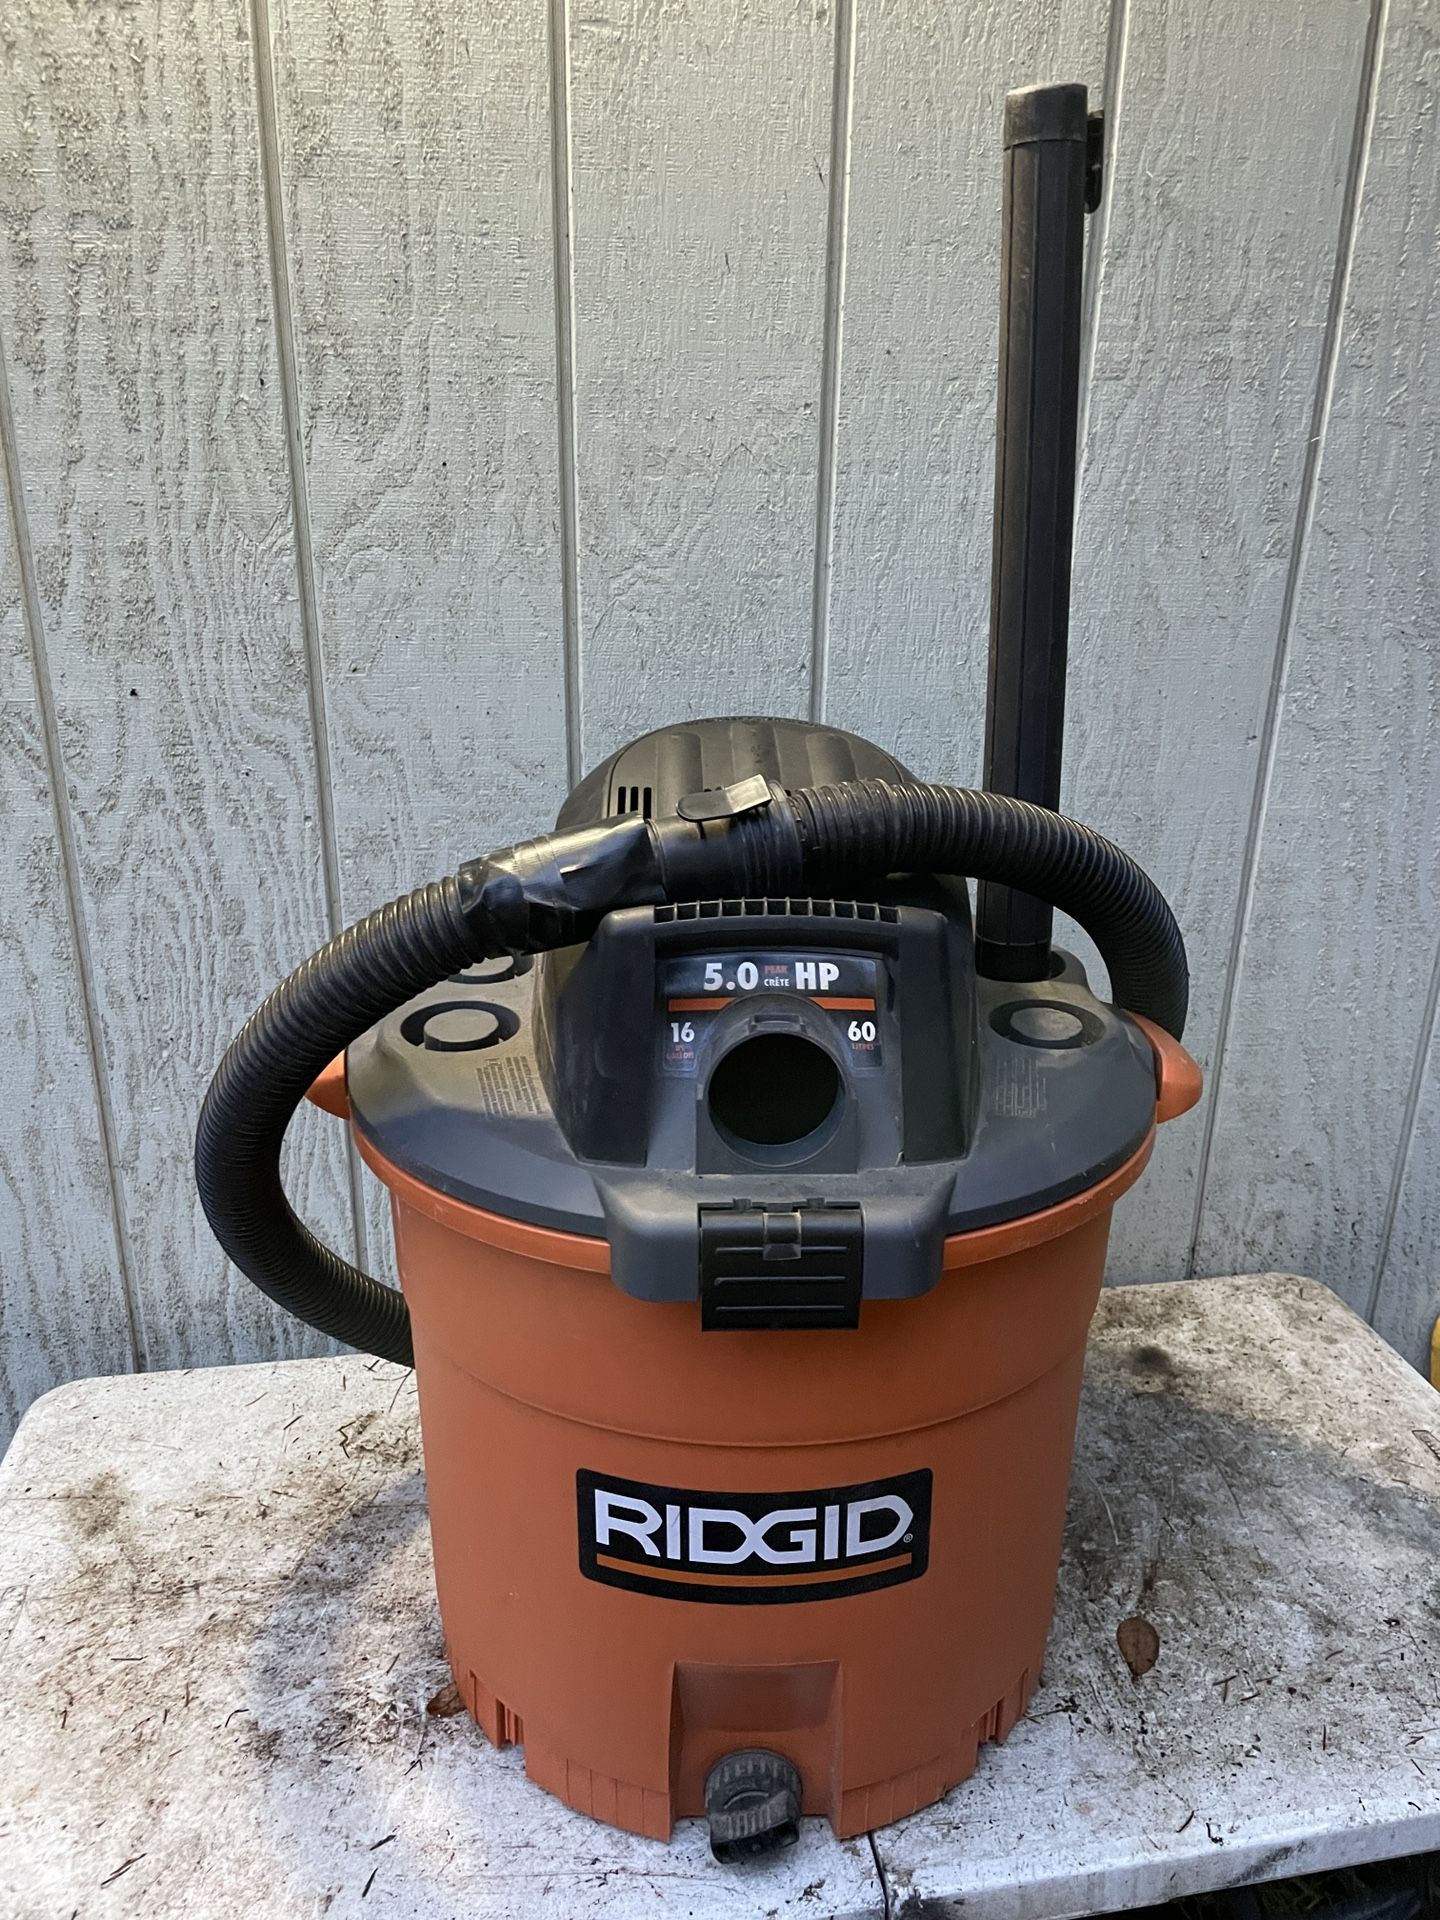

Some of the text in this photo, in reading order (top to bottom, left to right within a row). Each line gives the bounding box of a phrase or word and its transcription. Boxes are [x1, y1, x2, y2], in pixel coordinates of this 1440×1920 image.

[704, 961, 759, 991] 5.0
[795, 961, 840, 990] HP
[670, 1022, 695, 1043] 16
[847, 1021, 876, 1042] 60
[594, 1489, 914, 1565] RIDGID
